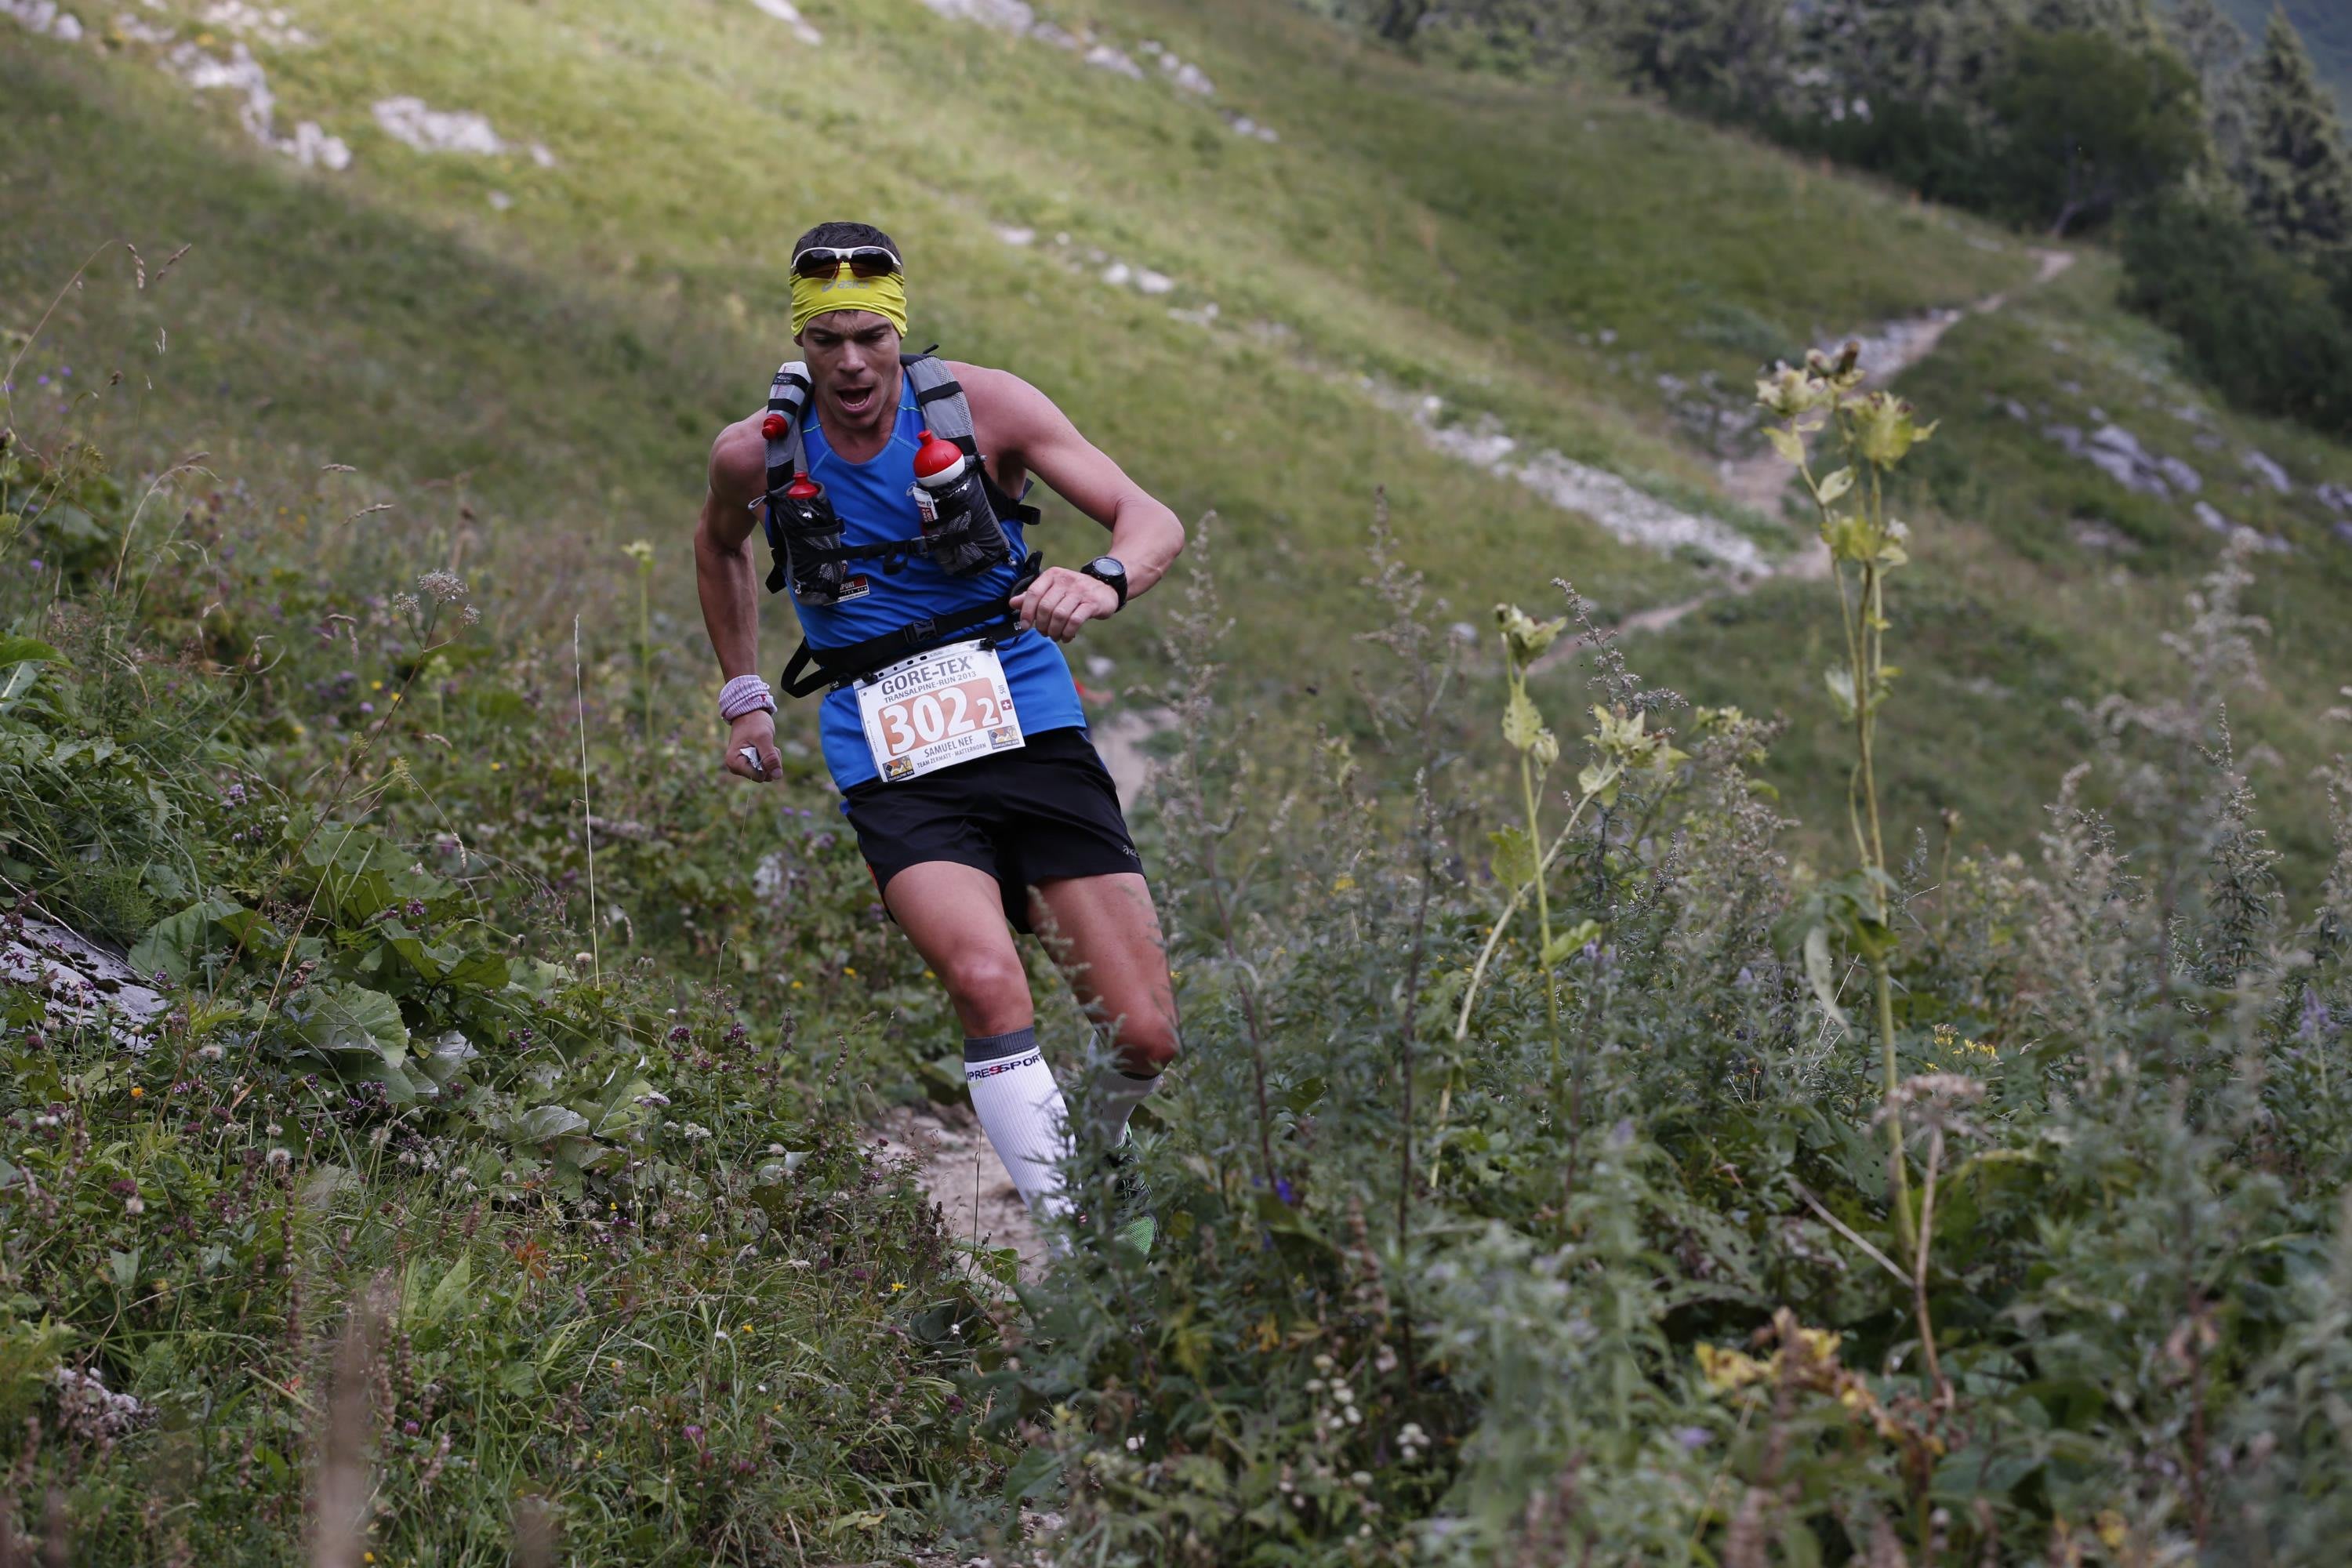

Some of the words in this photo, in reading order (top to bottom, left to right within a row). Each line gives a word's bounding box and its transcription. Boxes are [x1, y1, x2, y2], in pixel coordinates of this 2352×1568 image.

[837, 280, 869, 289] asics
[881, 656, 971, 696] GORE-TEX
[957, 670, 977, 681] 2013
[924, 741, 957, 758] SAMUEL
[958, 735, 973, 747] NEF
[916, 760, 930, 768] TEAM
